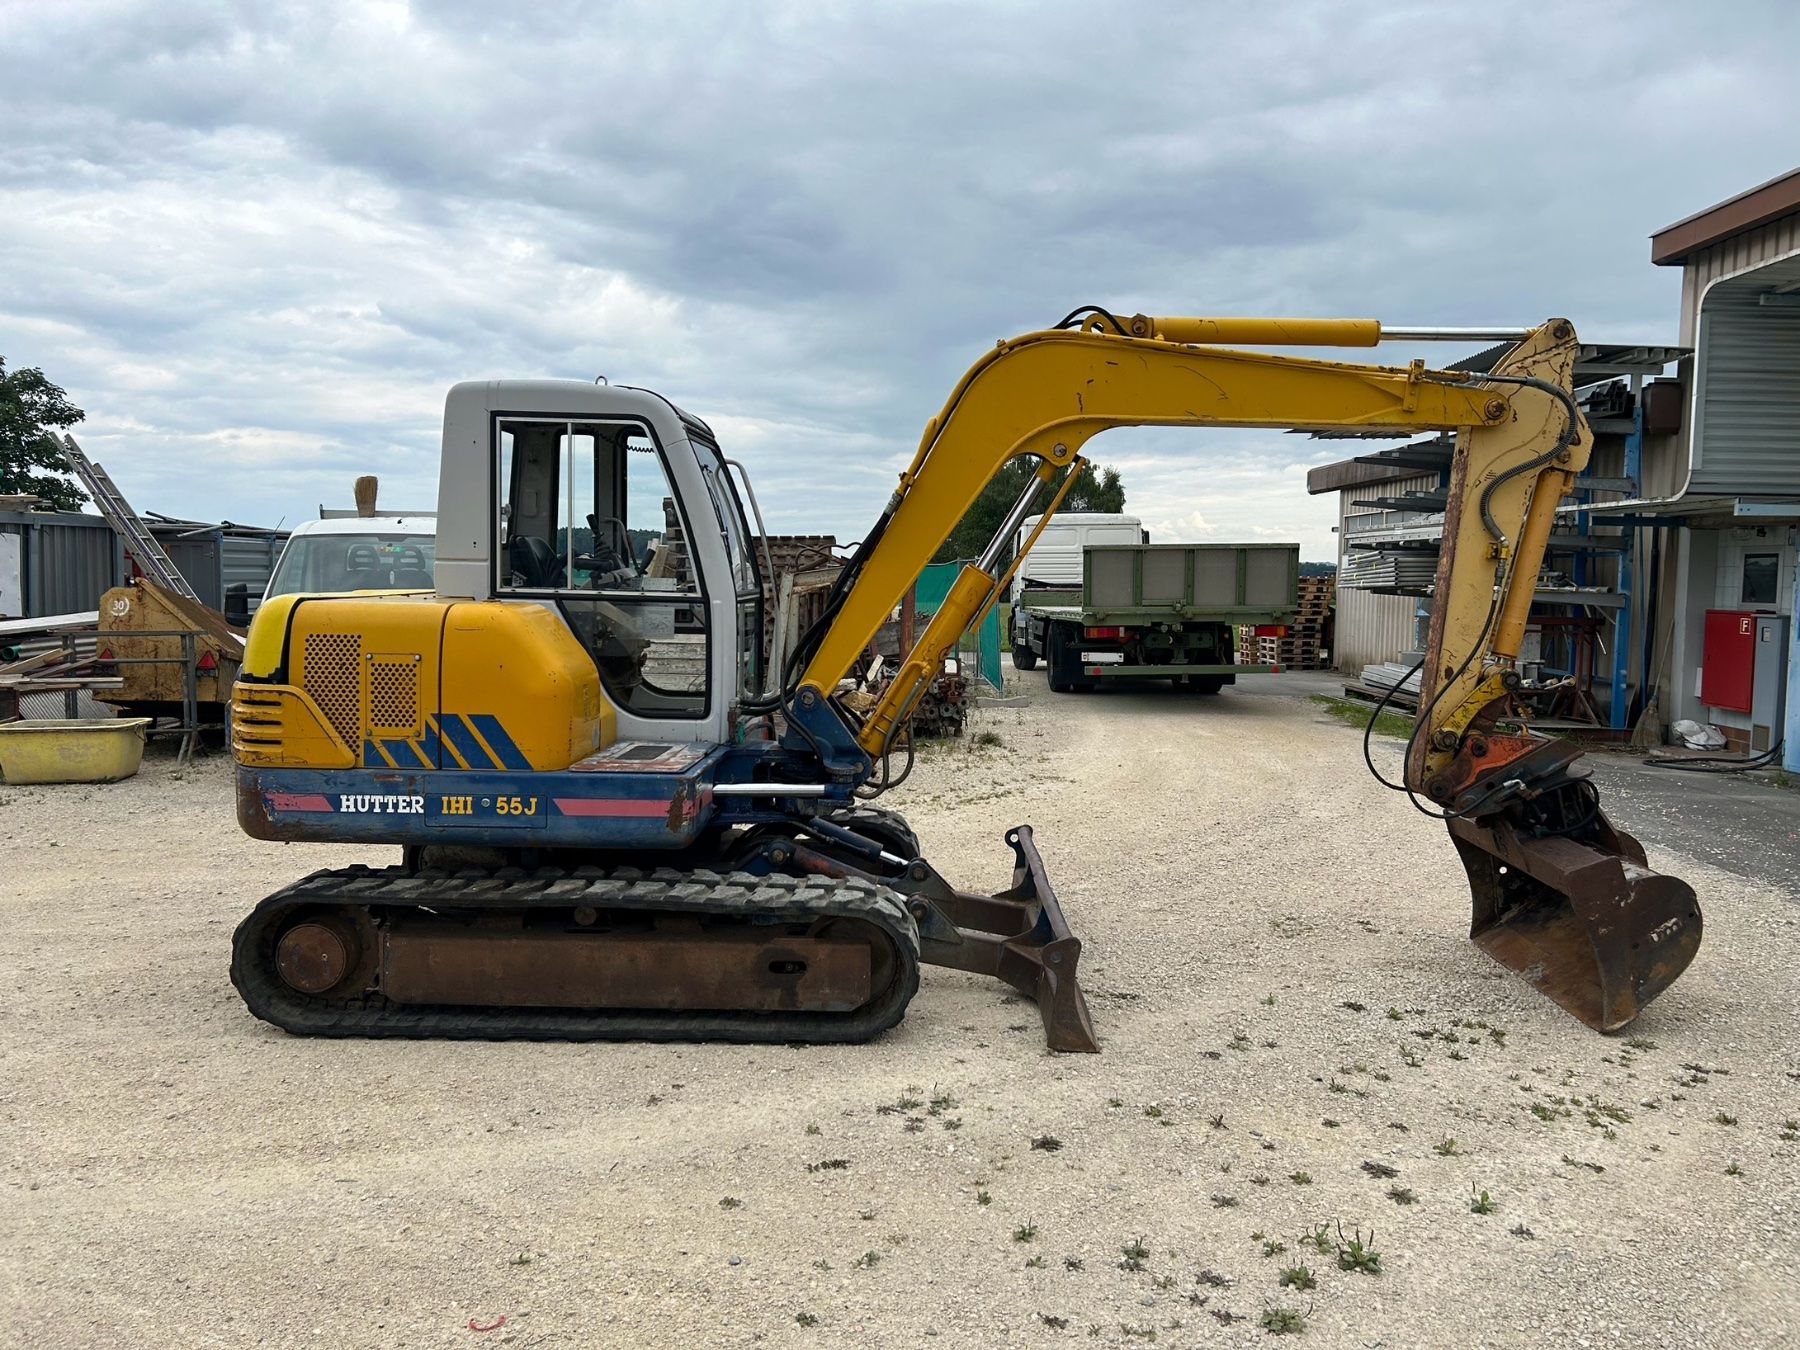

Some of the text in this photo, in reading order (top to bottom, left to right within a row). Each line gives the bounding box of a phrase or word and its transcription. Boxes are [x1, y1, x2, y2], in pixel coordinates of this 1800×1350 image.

[113, 600, 124, 610] 30
[1742, 620, 1749, 632] F
[340, 795, 425, 814] HUTTER
[441, 796, 538, 815] IHI 55J
